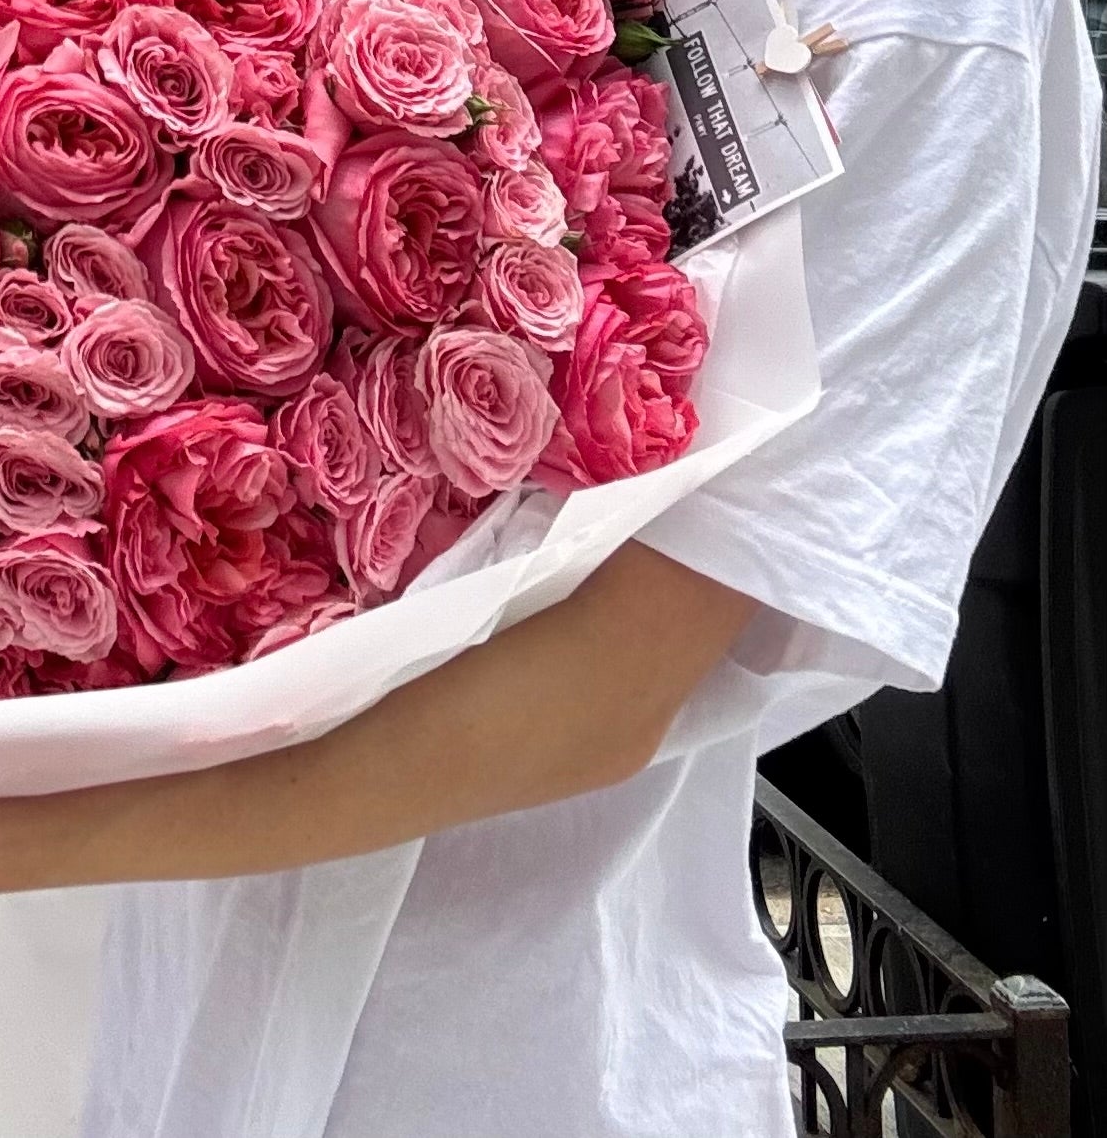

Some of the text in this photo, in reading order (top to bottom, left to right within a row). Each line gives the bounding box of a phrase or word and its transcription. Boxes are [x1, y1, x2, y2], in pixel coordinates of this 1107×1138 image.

[683, 36, 755, 199] FOLLOW THAT DREAM
